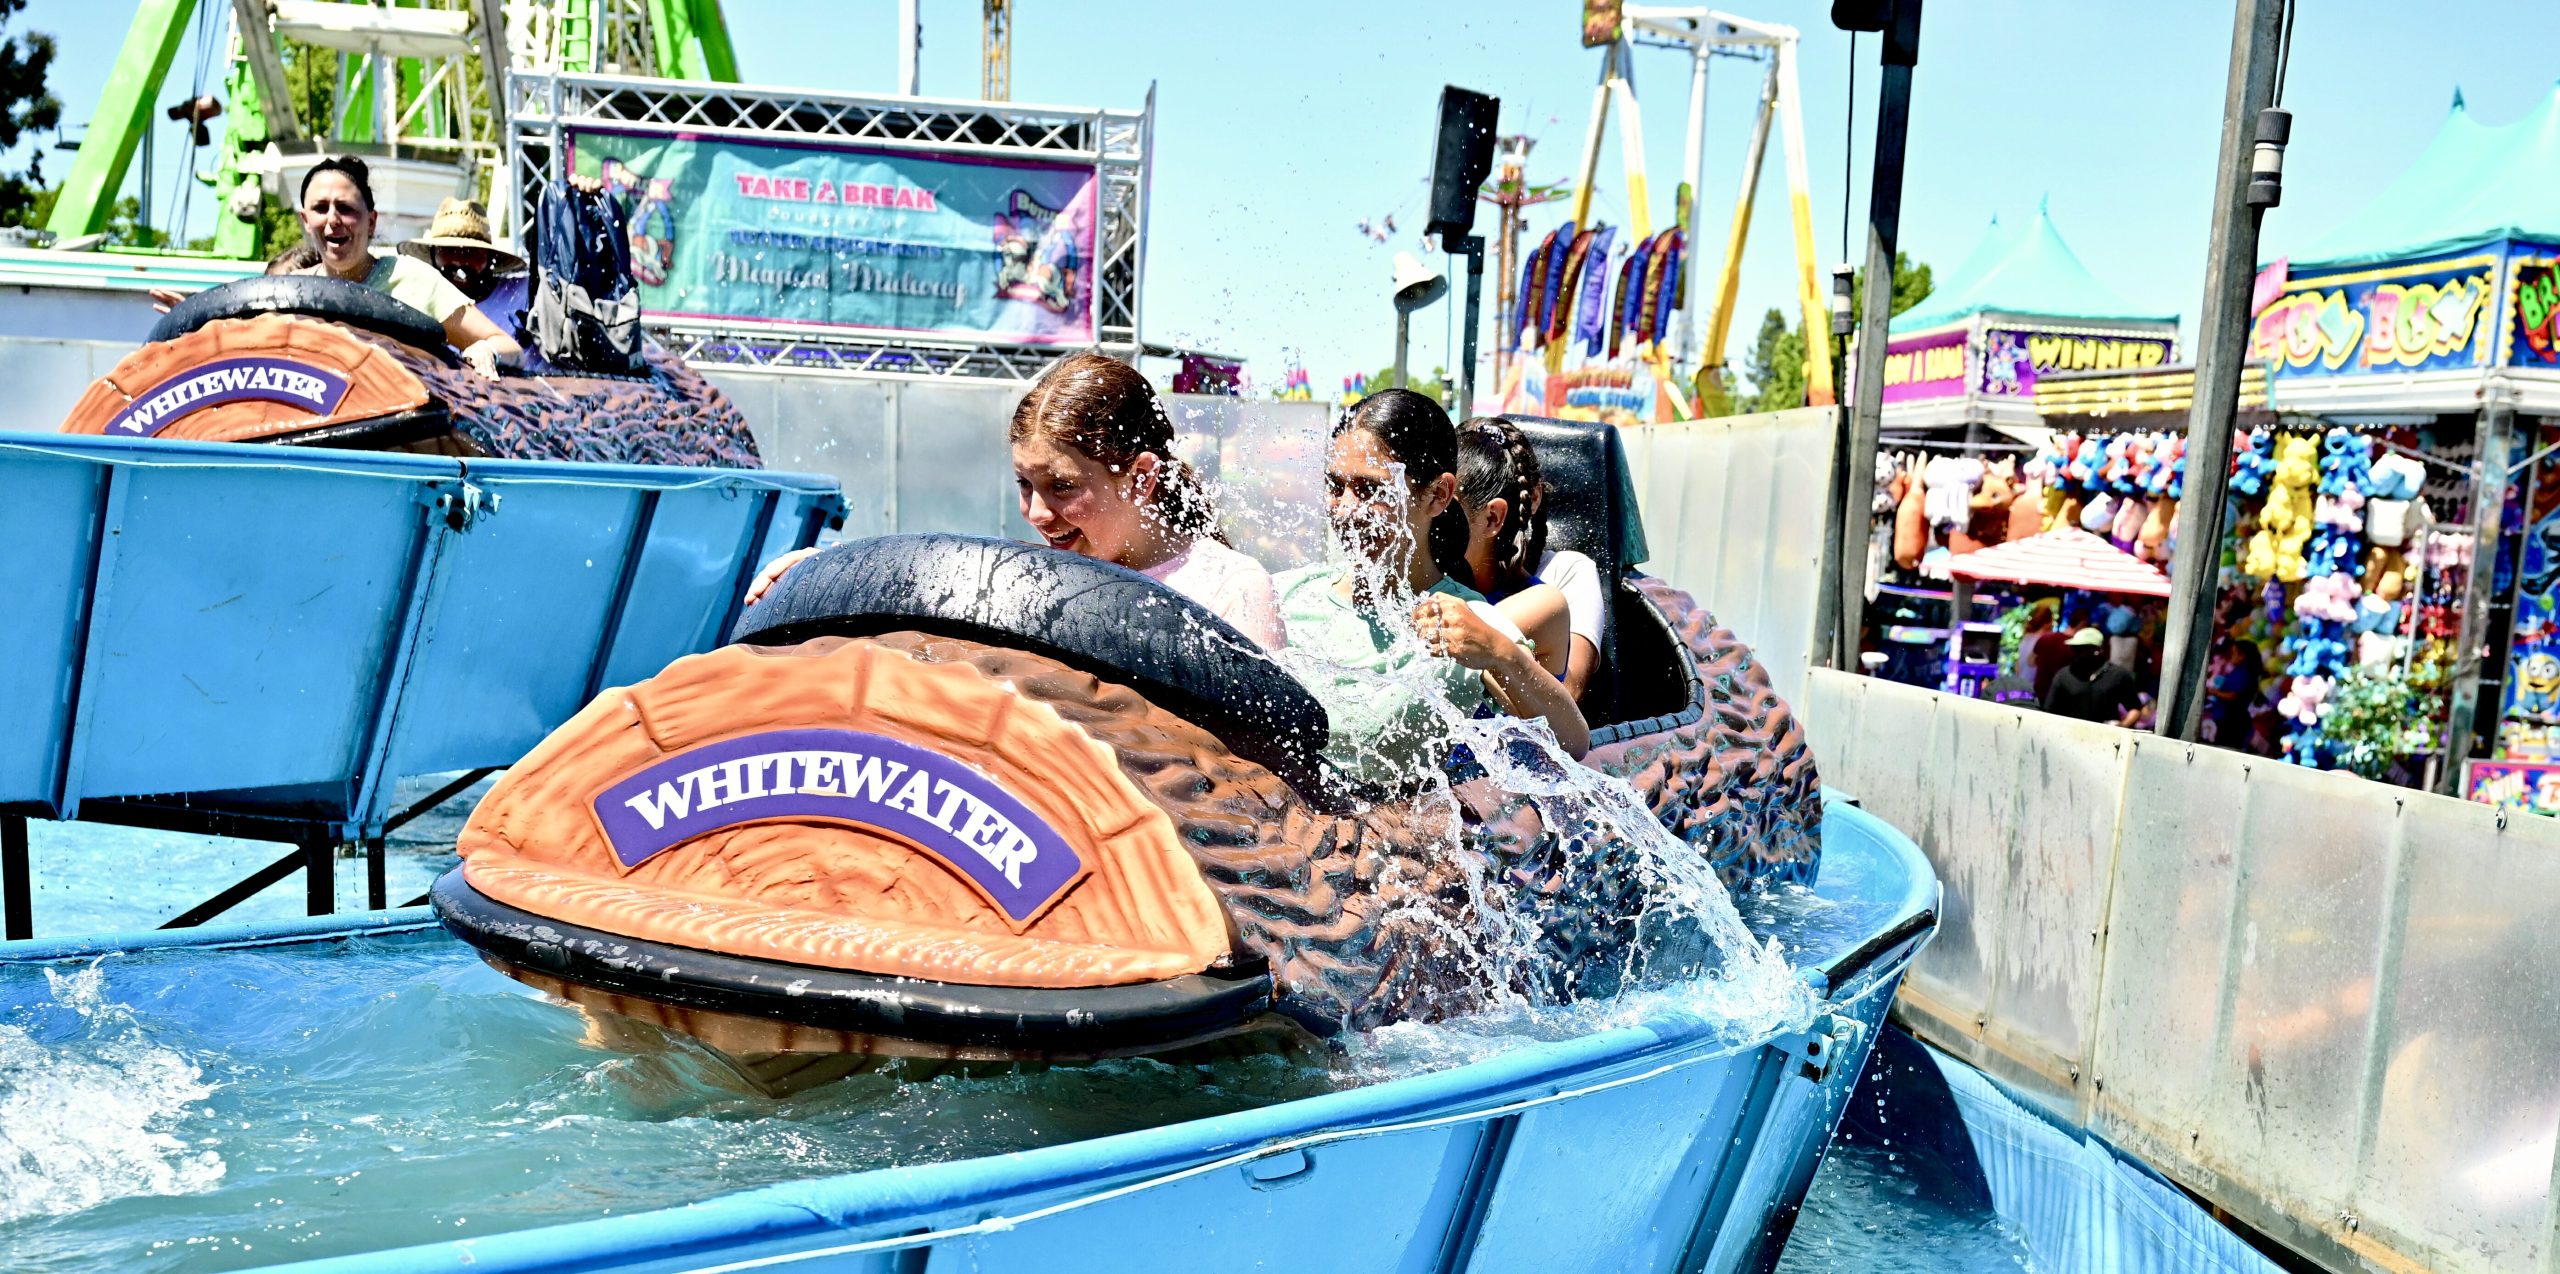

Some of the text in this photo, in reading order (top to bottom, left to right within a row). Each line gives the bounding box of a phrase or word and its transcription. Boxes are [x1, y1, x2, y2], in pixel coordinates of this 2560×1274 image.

[735, 174, 936, 211] TAKE A BREAK
[2027, 333, 2166, 372] WINNER
[2257, 280, 2482, 360] TOY BOX
[119, 367, 328, 433] WHITEWATER
[625, 750, 1038, 889] WHITEWATER
